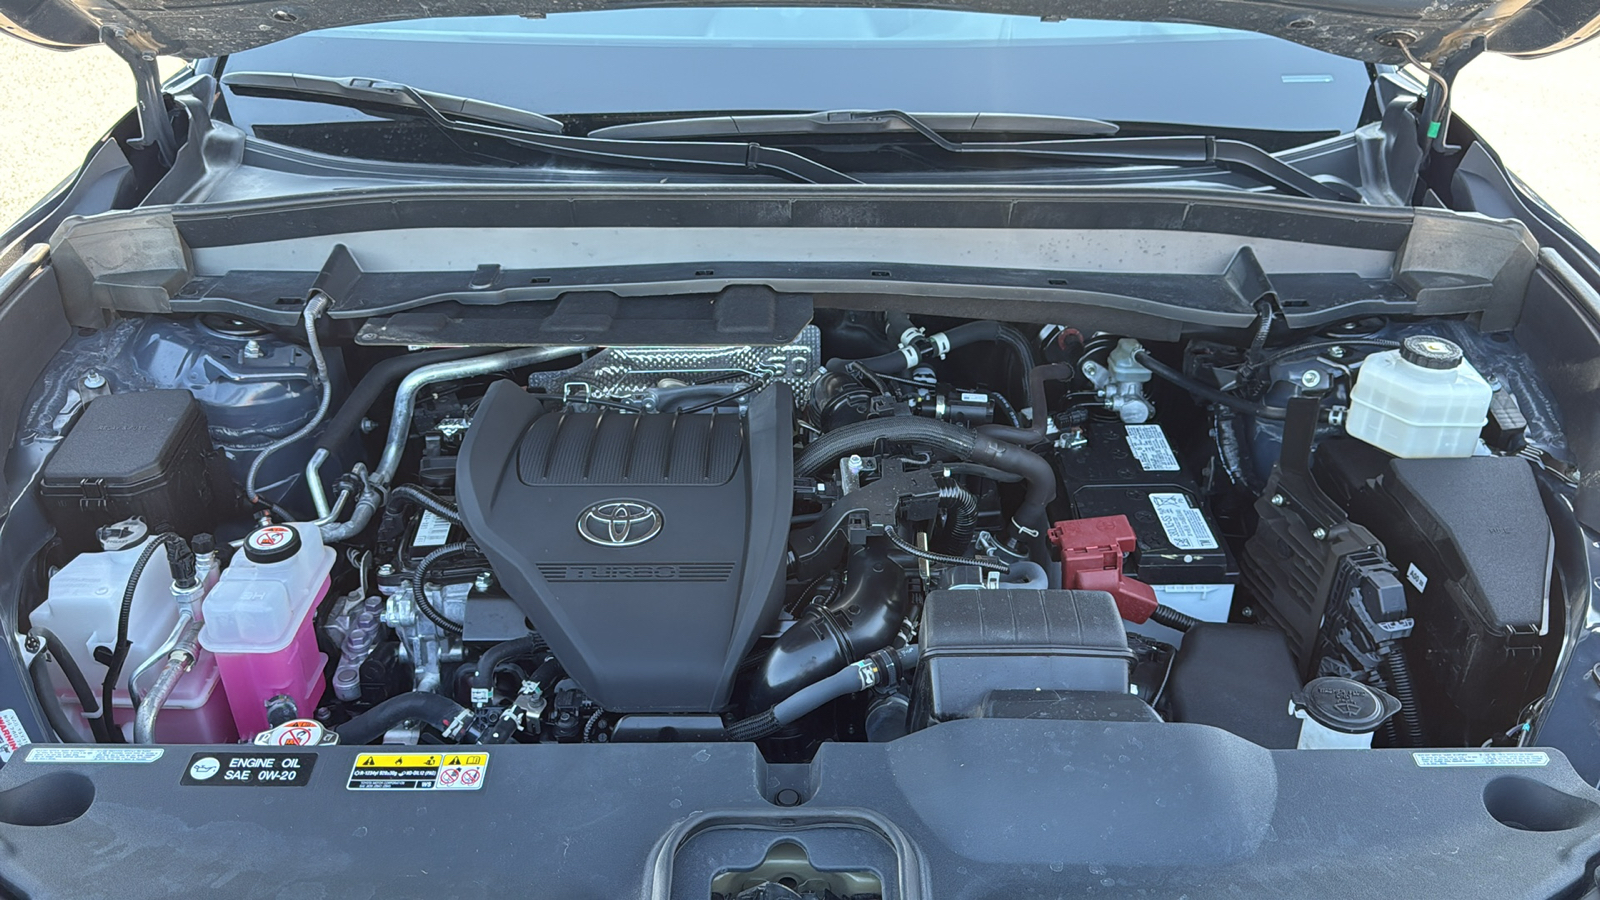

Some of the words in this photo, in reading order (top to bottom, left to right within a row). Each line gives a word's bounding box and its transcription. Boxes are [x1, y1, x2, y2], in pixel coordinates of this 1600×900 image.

[570, 566, 676, 578] TURBO
[0, 716, 18, 751] WARNIN
[229, 758, 275, 768] ENGINE
[281, 758, 301, 768] OIL
[224, 770, 251, 780] SAE
[258, 770, 297, 781] 0W-20
